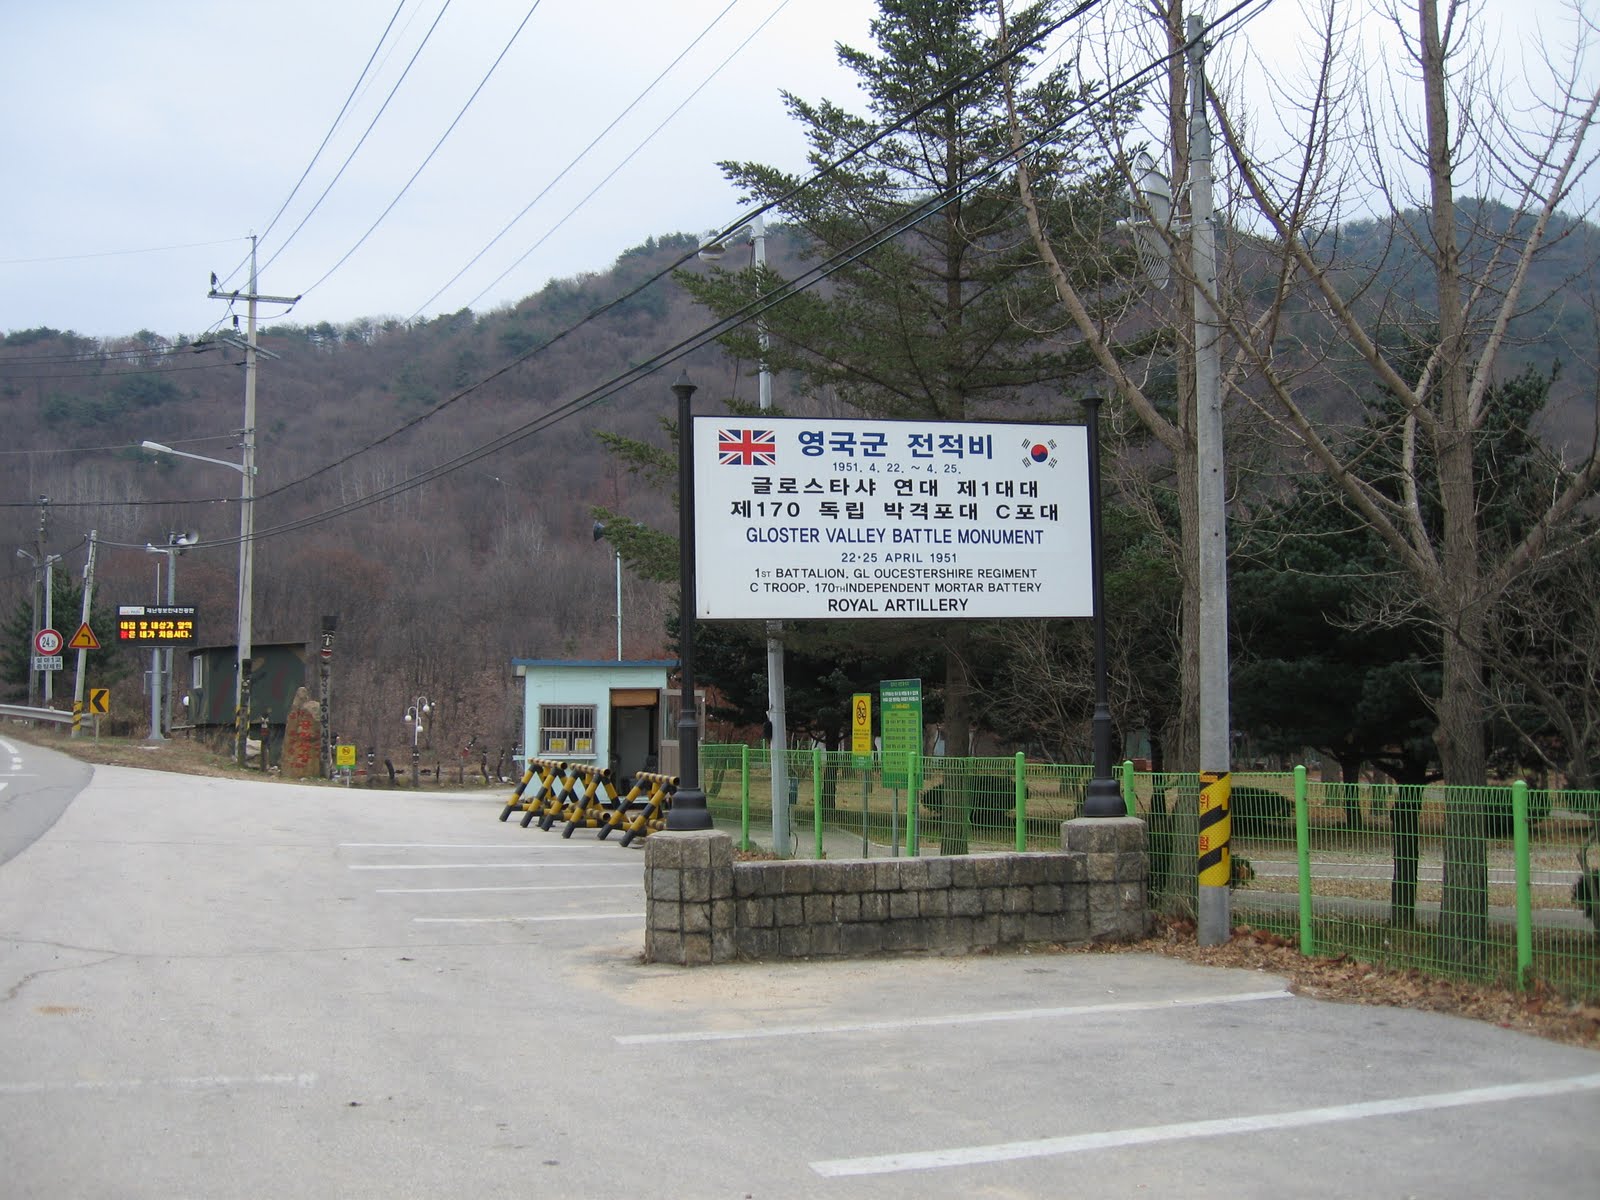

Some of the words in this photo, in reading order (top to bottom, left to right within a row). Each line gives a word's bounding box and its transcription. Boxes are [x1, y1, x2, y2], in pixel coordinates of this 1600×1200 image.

[798, 431, 888, 457] 영국군
[907, 433, 992, 459] 전적비
[833, 462, 862, 472] 1951.
[870, 463, 879, 473] 4.
[887, 463, 904, 473] 22.
[927, 464, 937, 474] 4.
[944, 464, 961, 474] 25.
[751, 477, 876, 496] 글로스타샤
[894, 479, 937, 497] 연대
[957, 480, 1037, 498] 제1대대
[731, 500, 800, 518] 제170
[819, 502, 864, 519] 독립
[884, 502, 977, 520] 박격포대
[996, 504, 1058, 521] C포대
[747, 527, 820, 543] GLOSTER
[826, 528, 886, 543] VALLEY
[893, 528, 952, 543] BATTLE
[958, 529, 1044, 544] MONUMENT
[885, 553, 923, 562] APRIL
[930, 553, 956, 563] 1951
[978, 569, 1037, 578] REGIMENT
[750, 583, 758, 592] C
[935, 583, 984, 592] MORTAR
[988, 583, 1042, 592] BATTERY
[828, 599, 878, 612] ROYAL
[885, 598, 968, 611] ARTILLERY
